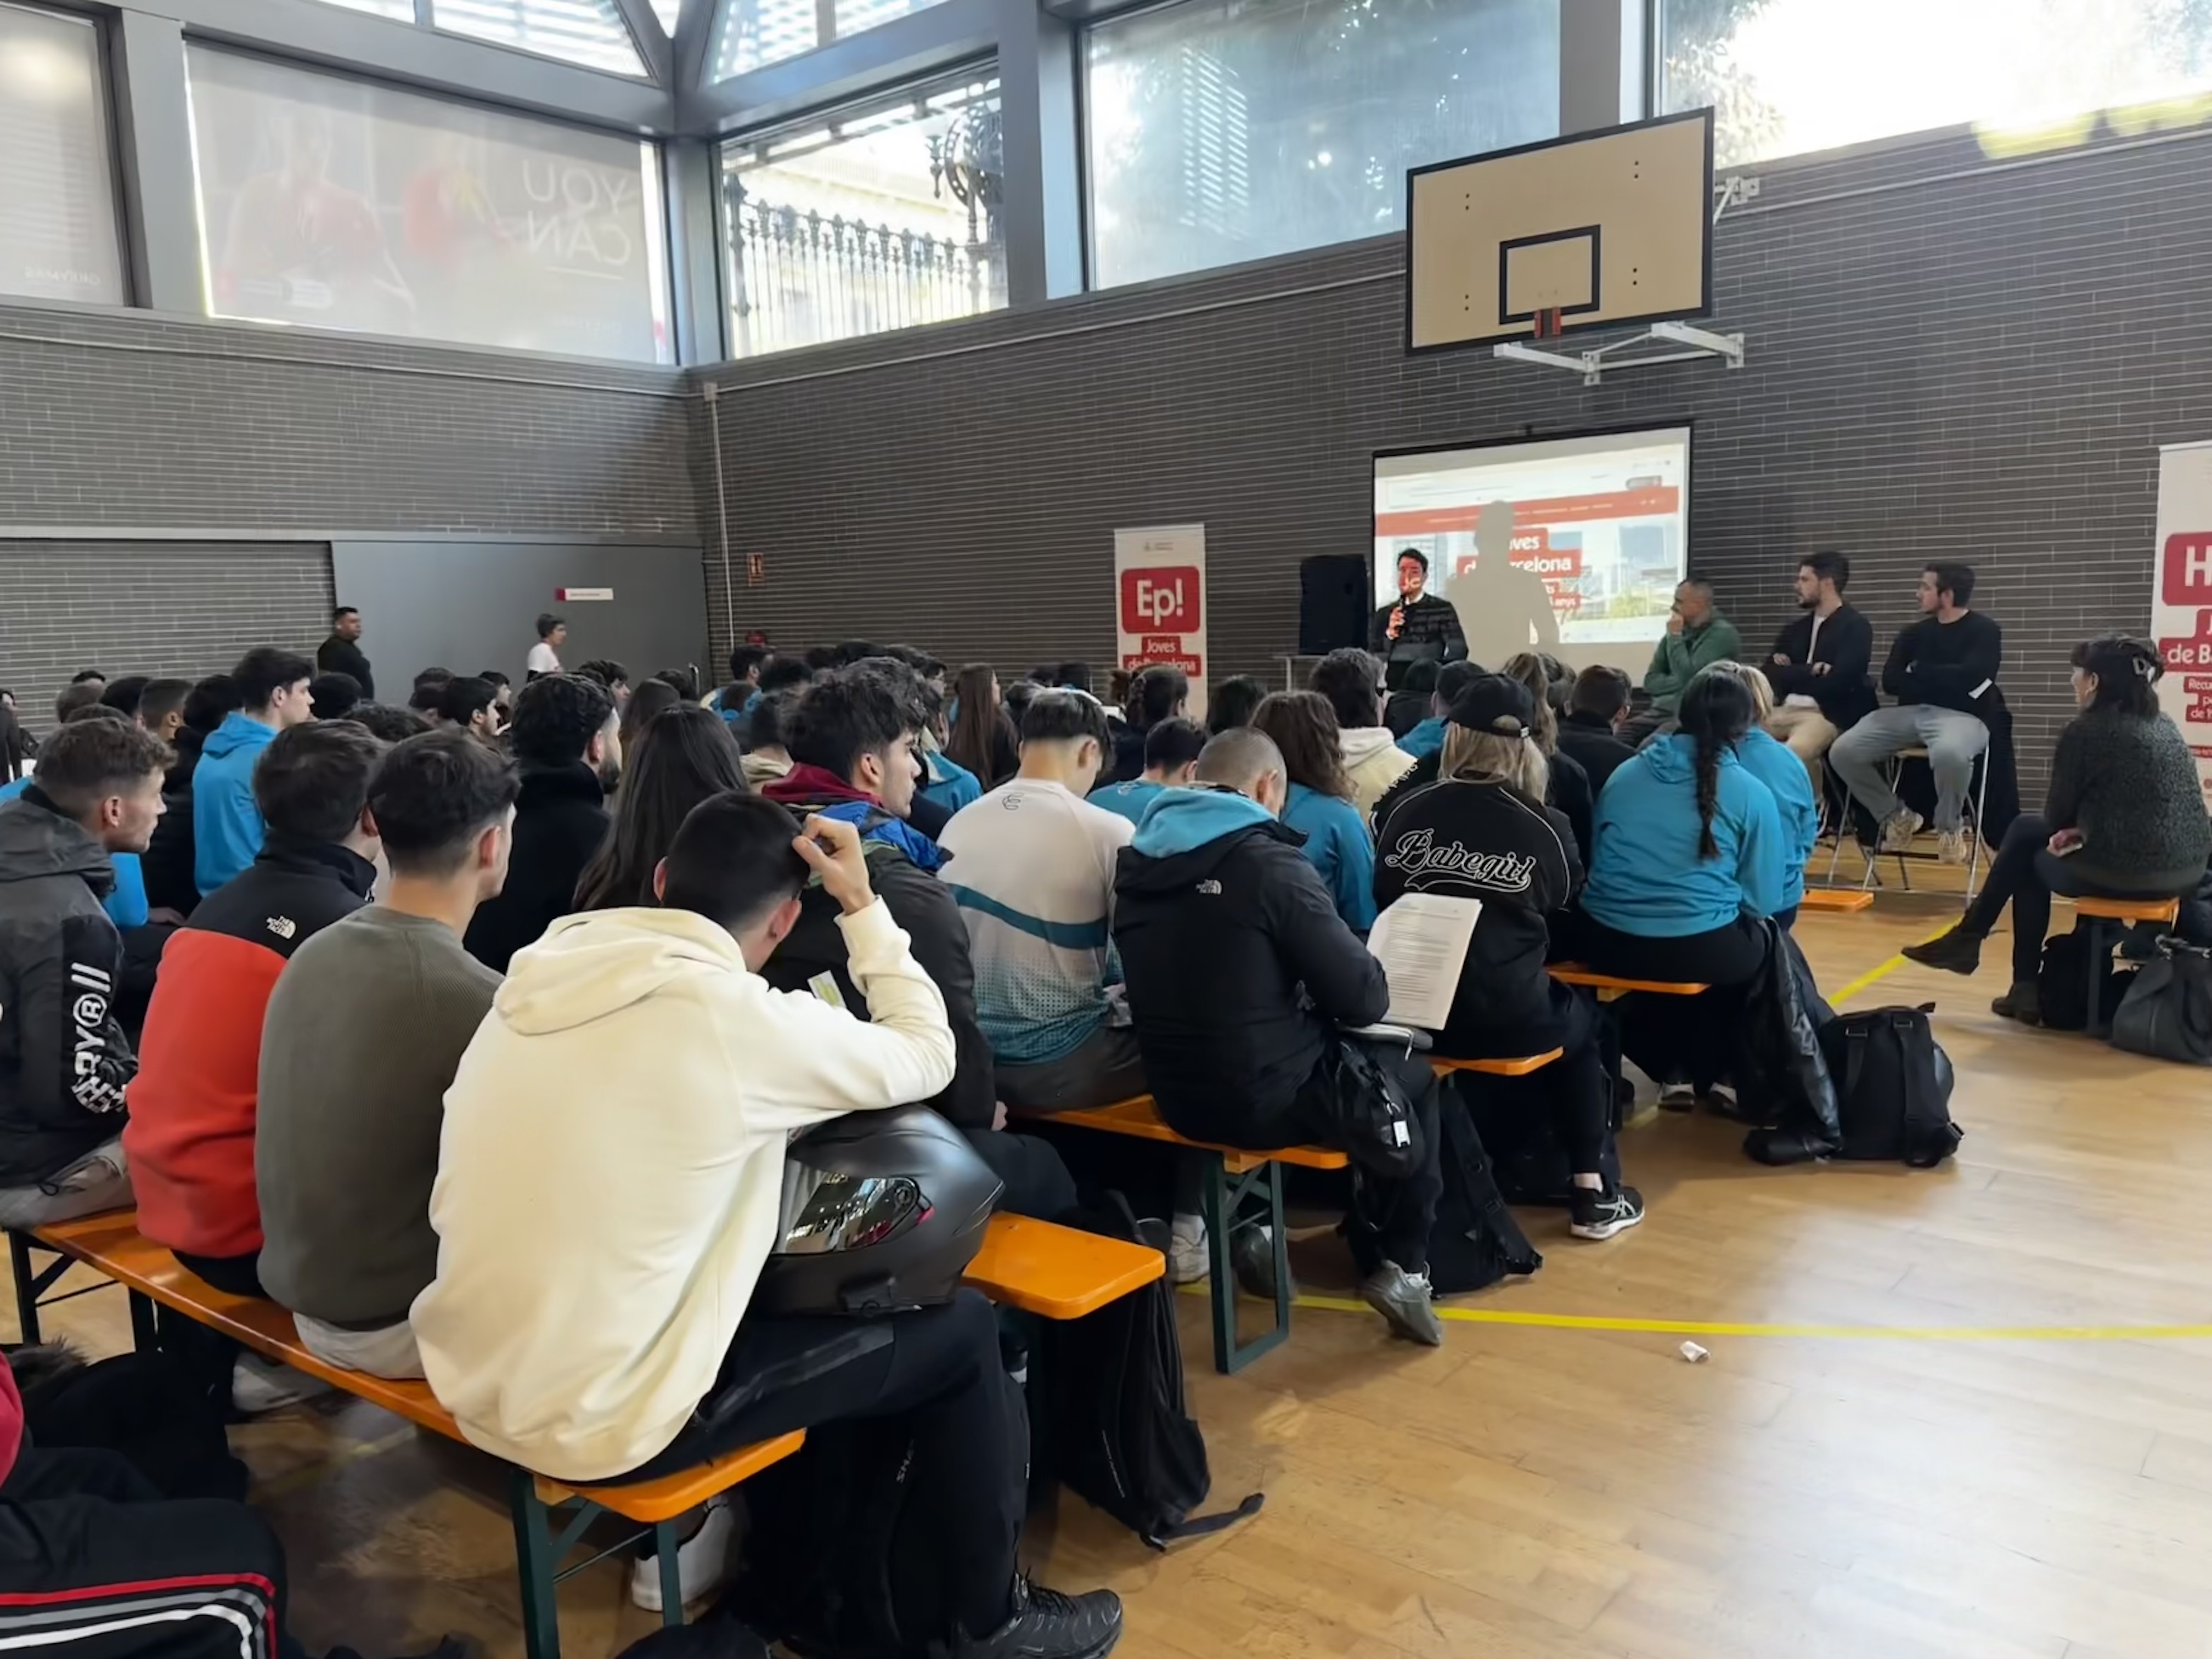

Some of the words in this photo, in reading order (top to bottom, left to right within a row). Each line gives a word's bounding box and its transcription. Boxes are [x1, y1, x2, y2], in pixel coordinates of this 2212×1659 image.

[1509, 536, 1540, 551] ves
[2185, 545, 2212, 586] H
[1137, 578, 1183, 625] Ep!
[1146, 639, 1176, 653] Joves
[2167, 643, 2194, 664] de
[2198, 644, 2212, 664] B
[2188, 678, 2212, 690] Recu
[1385, 827, 1536, 885] Babegirl
